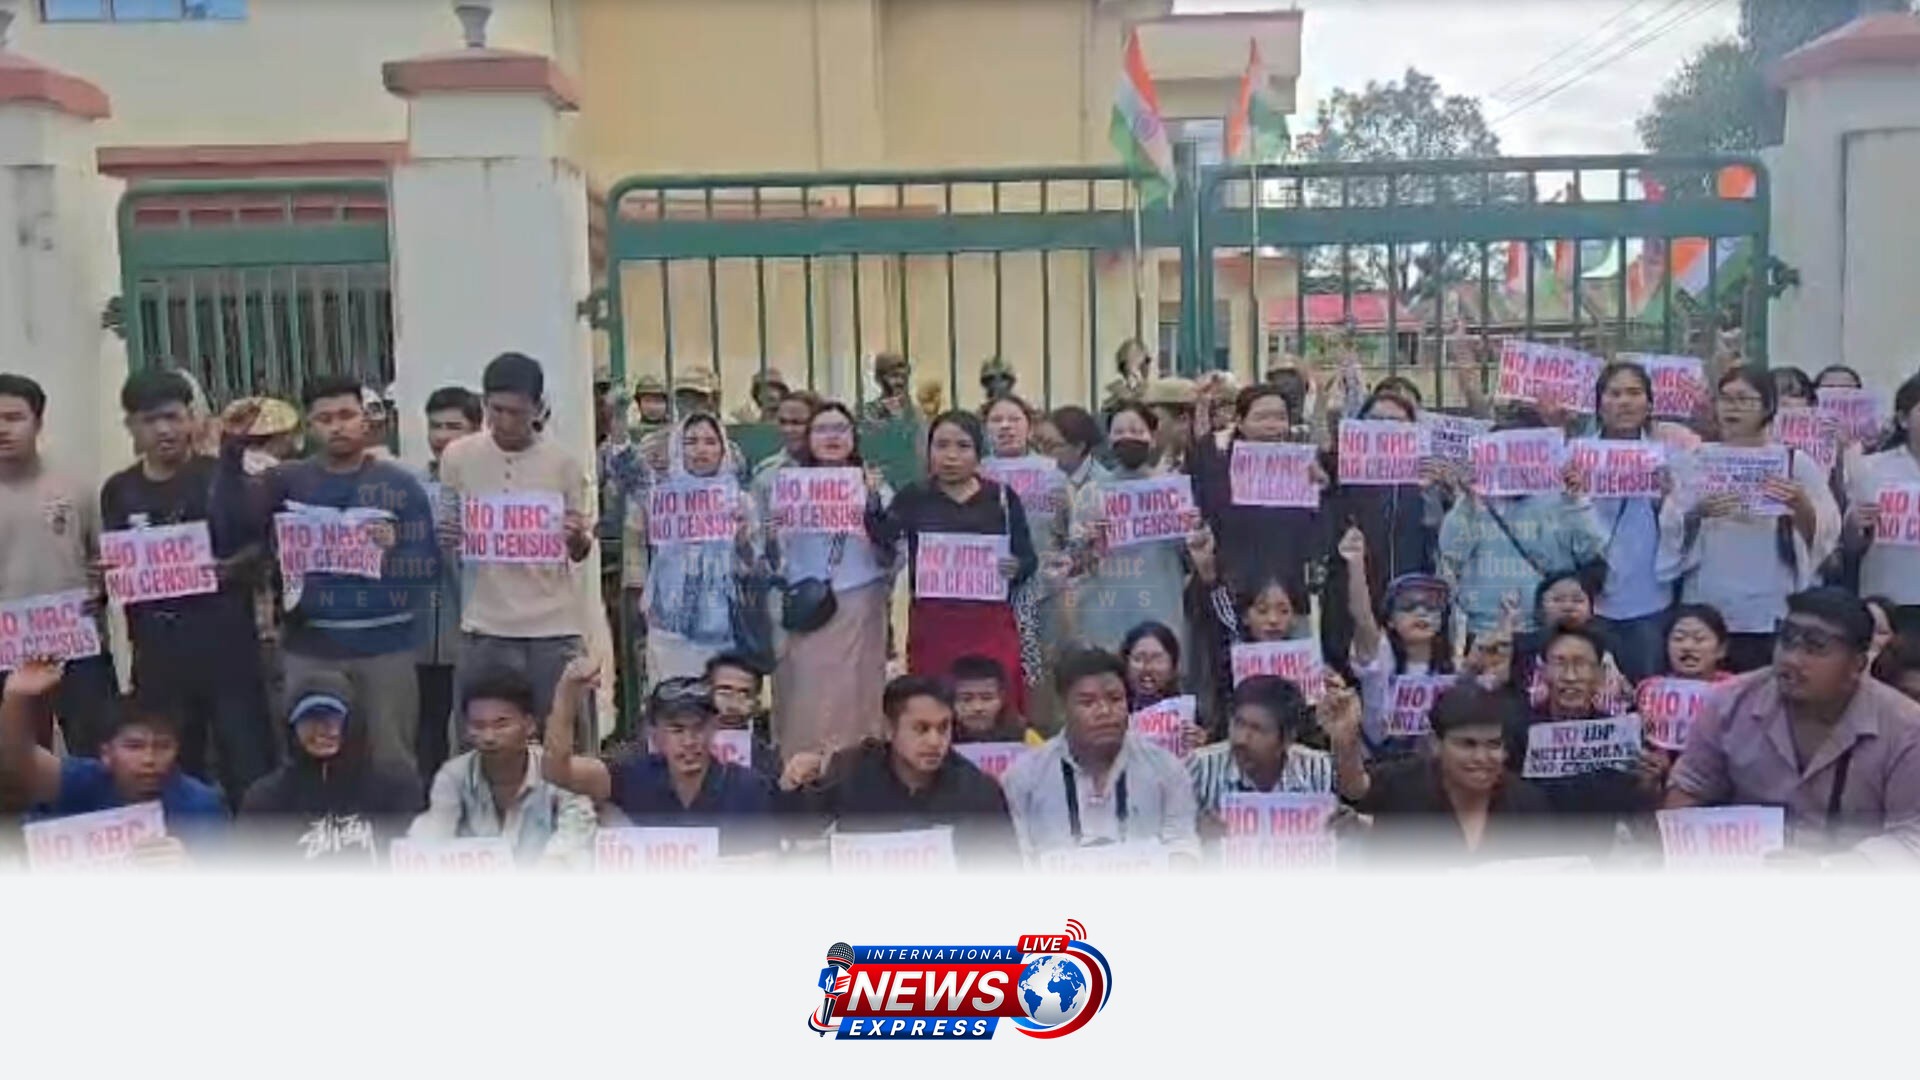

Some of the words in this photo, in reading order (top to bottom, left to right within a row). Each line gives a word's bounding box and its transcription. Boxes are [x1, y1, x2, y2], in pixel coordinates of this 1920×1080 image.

[1503, 351, 1528, 375] NO
[1502, 374, 1519, 395] NO
[1343, 431, 1368, 454] NO
[1474, 442, 1498, 465] NO
[775, 475, 801, 501] NO
[465, 499, 494, 530] NO
[652, 490, 677, 515] NO
[1104, 492, 1131, 517] NO
[1880, 491, 1909, 514] NO
[652, 517, 671, 539] NO
[801, 504, 862, 528] CENSUS
[282, 522, 311, 548] NO
[465, 533, 487, 556] NO
[495, 533, 563, 557] CENSUS
[104, 541, 136, 566] NO
[283, 551, 306, 573] NO
[109, 574, 134, 601] NO
[140, 564, 213, 594] CENSUS
[1397, 685, 1425, 708] NO
[1650, 691, 1680, 716] NO
[1552, 727, 1577, 744] NO
[1224, 806, 1257, 835] NO
[33, 831, 73, 861] NO
[598, 838, 634, 872] NO
